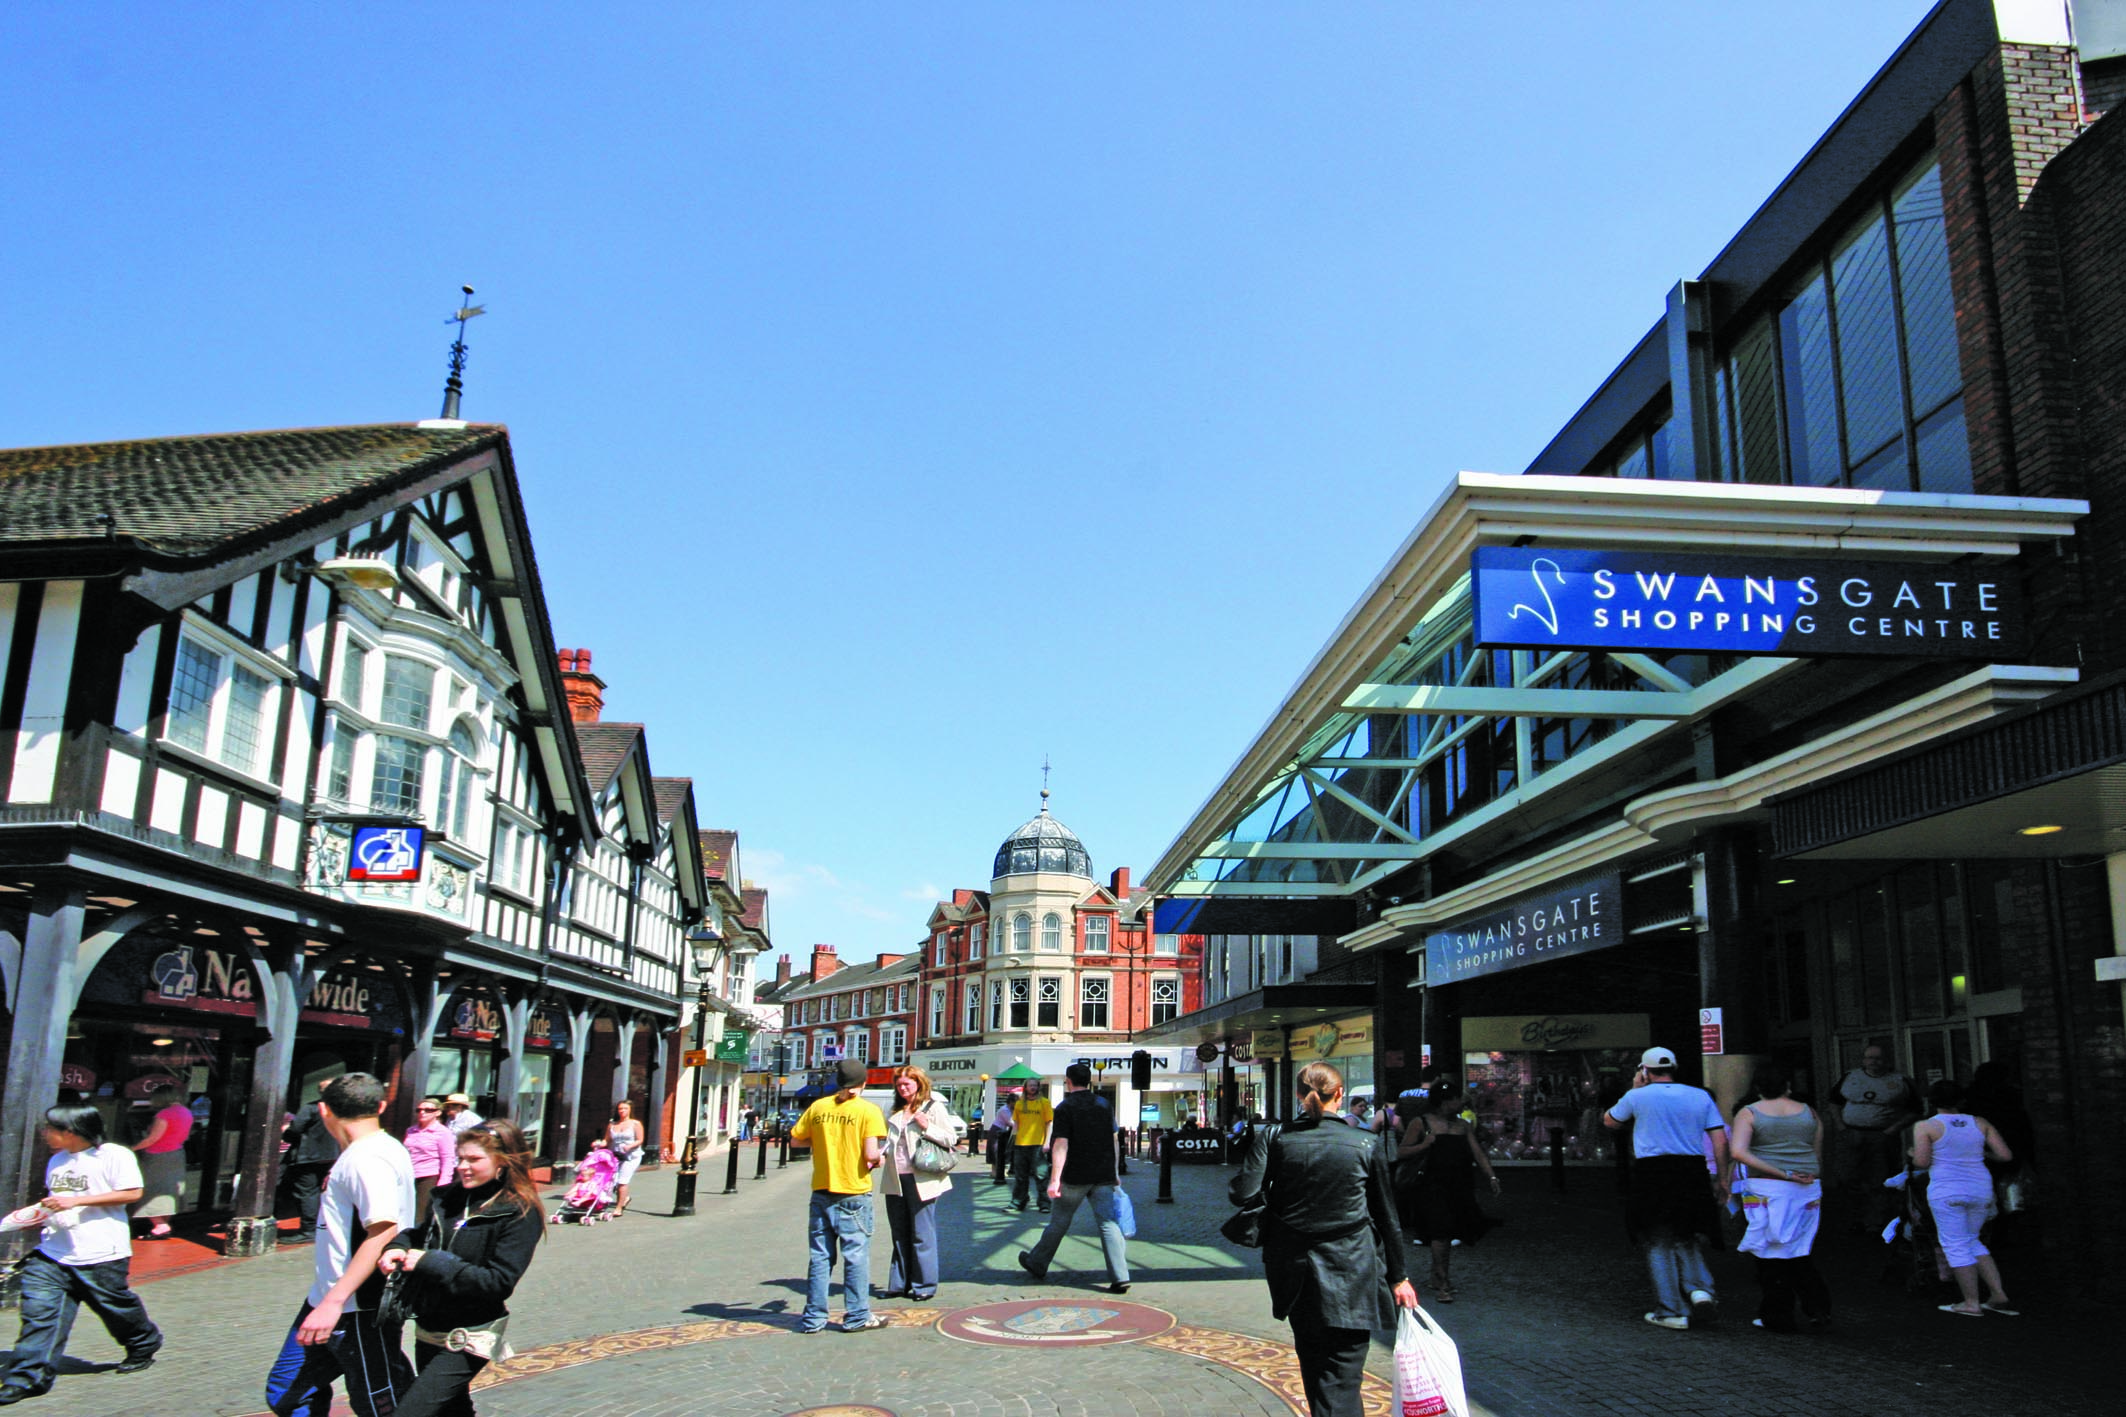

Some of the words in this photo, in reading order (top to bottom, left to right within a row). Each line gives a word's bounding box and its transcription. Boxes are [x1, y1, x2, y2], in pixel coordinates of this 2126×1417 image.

[1592, 568, 1999, 612] SWANSGATE
[1593, 607, 1817, 635] SHOPPING
[1848, 616, 2002, 640] CENTRE
[1456, 892, 1600, 954] SWANSGATE
[1456, 943, 1526, 971] SHOPPING
[1535, 922, 1601, 951] CENTRE
[1234, 1043, 1254, 1060] COSTA
[928, 1058, 977, 1072] BURTON
[1077, 1057, 1168, 1070] BURTN
[812, 1112, 857, 1127] rethink
[1175, 1138, 1220, 1150] COSTA
